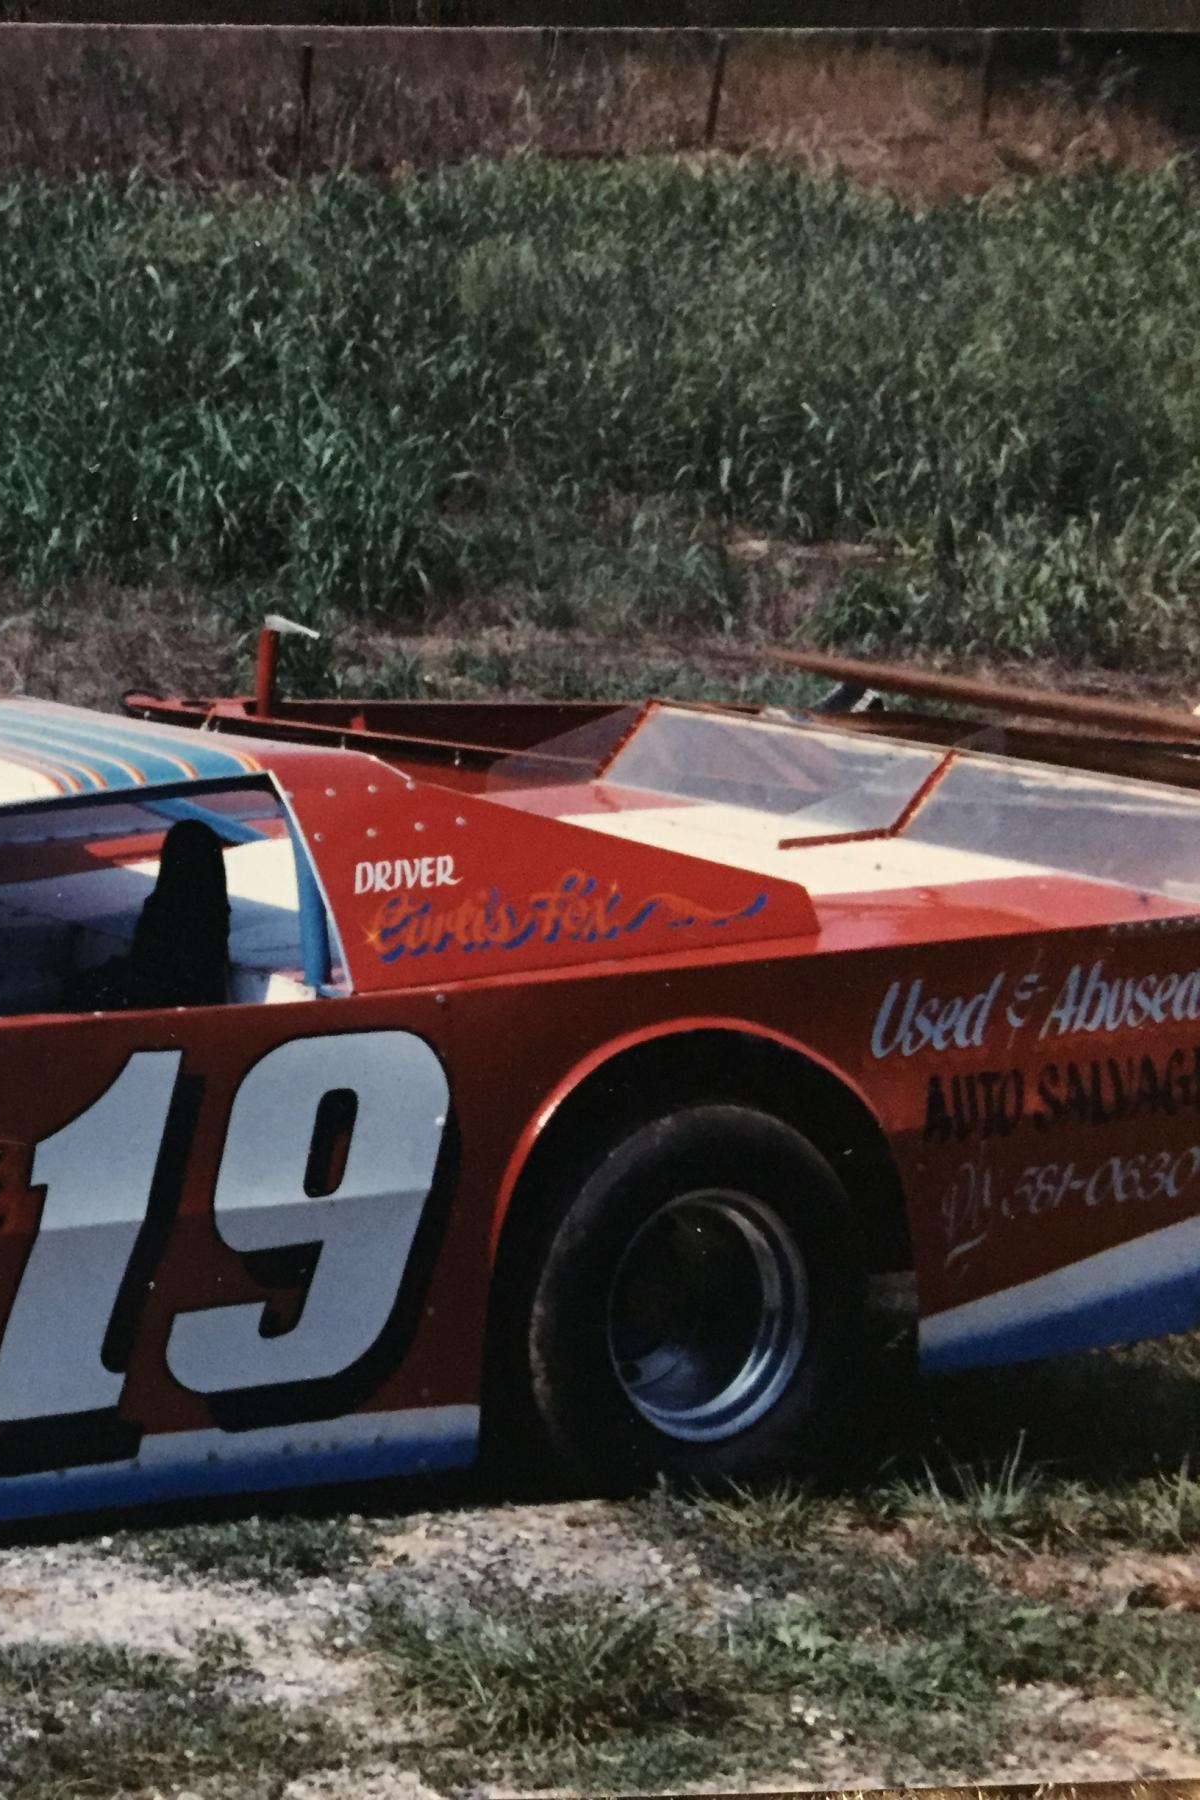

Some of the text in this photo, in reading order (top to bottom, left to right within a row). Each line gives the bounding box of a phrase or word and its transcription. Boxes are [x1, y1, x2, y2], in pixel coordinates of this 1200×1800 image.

[354, 855, 464, 894] DRIVER
[870, 971, 1006, 1059] Used
[1038, 959, 1200, 1041] Abused
[923, 1067, 1026, 1142] AUTO
